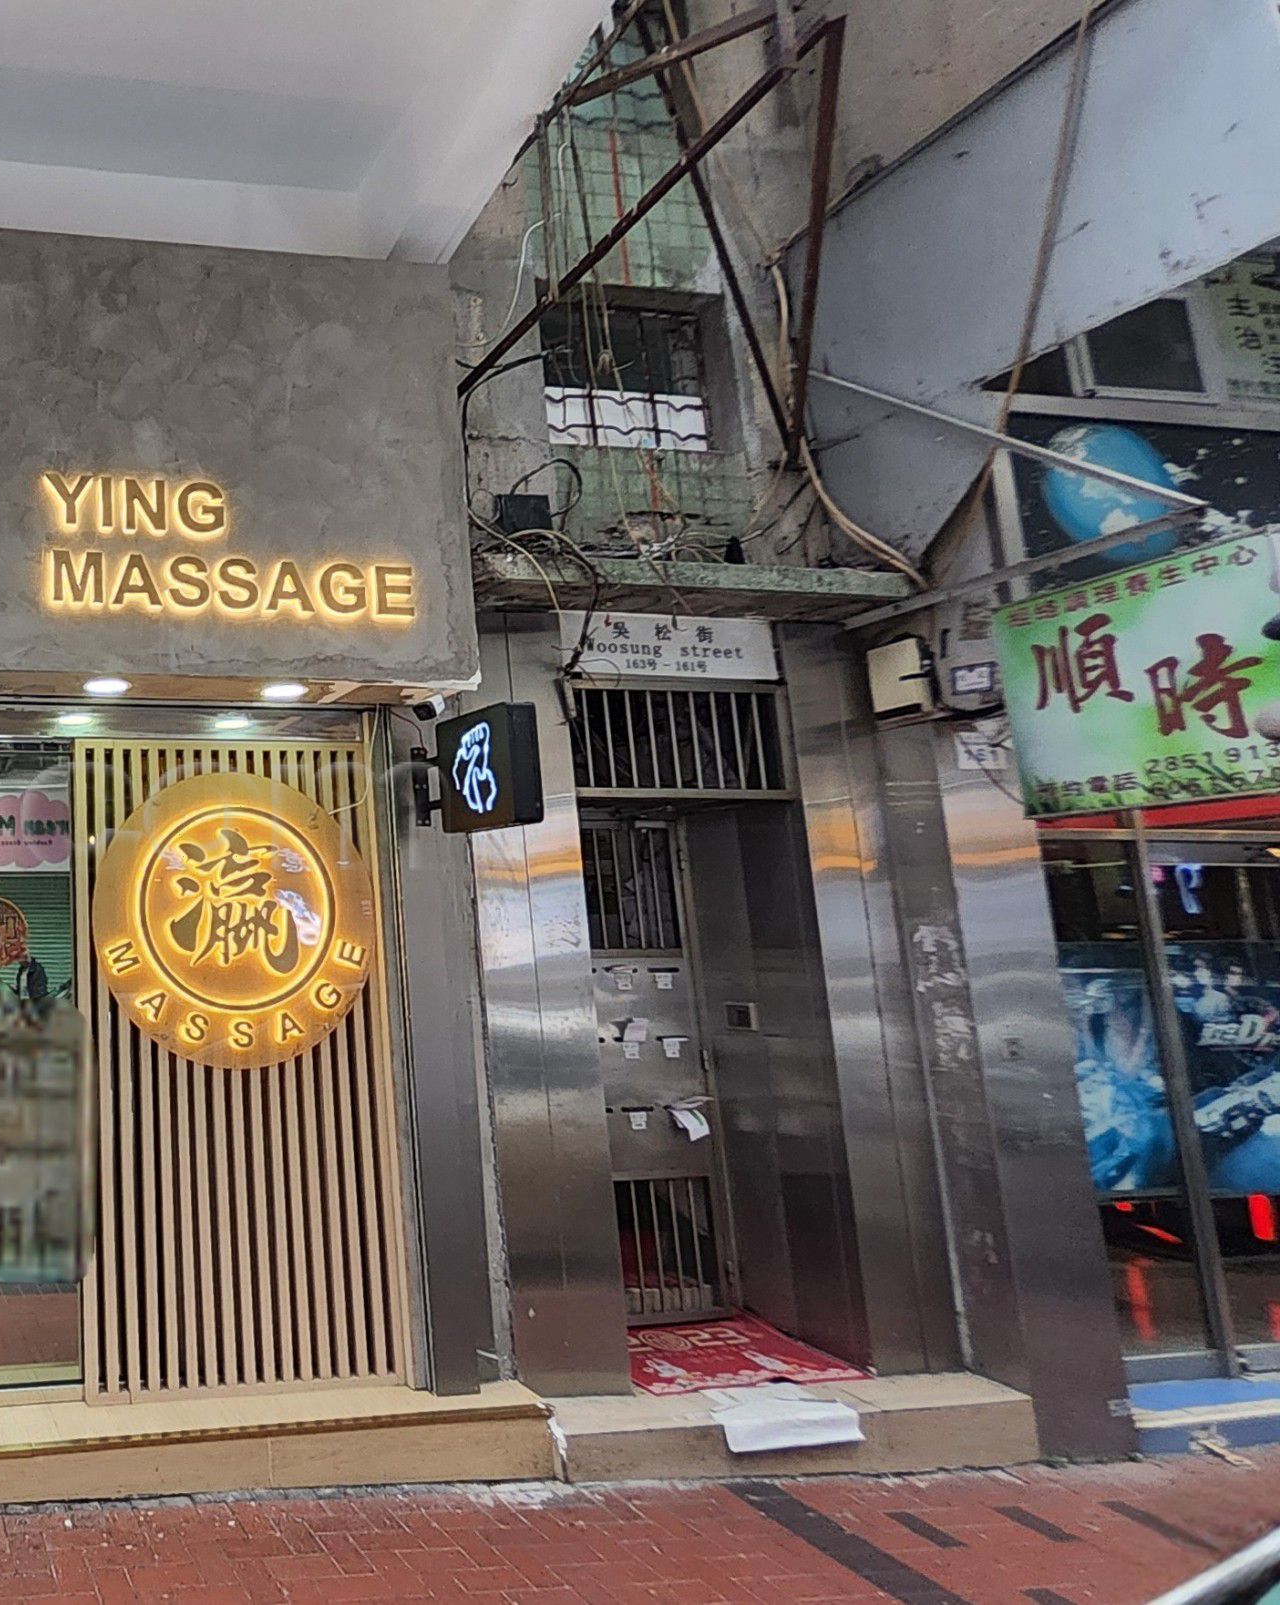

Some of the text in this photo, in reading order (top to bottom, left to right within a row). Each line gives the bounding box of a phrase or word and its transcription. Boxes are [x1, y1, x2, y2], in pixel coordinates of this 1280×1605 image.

[45, 472, 225, 533] YING
[51, 550, 416, 617] MASSAGE
[611, 621, 714, 644] 吳松街
[108, 941, 367, 1048] MASSAGE
